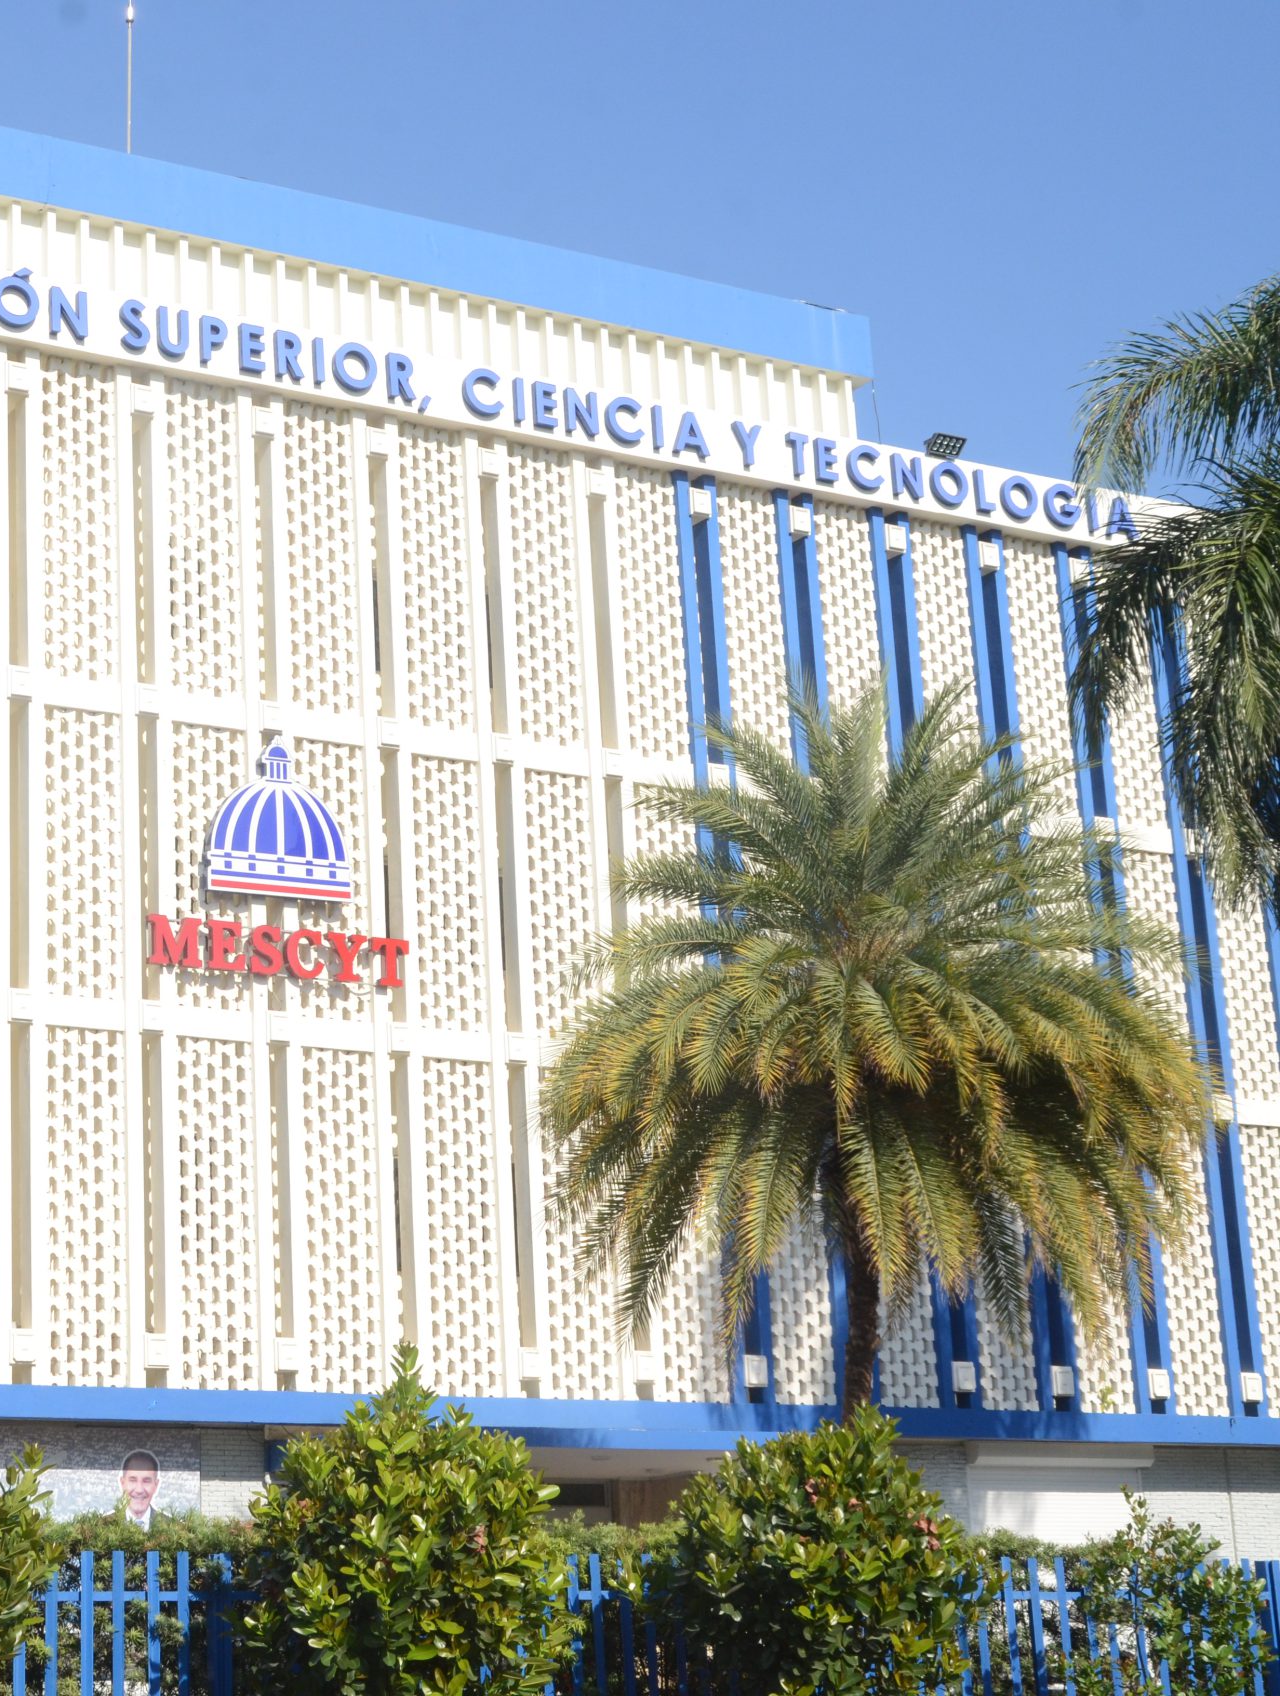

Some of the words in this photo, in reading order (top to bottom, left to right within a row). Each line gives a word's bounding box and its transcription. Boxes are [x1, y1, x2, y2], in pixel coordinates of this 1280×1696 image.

[120, 299, 432, 412] SUPERIOR,
[462, 368, 711, 459] CIENCIA
[731, 420, 761, 468] Y
[785, 431, 1141, 540] TECNOLOGIA
[146, 914, 409, 988] MESCYT
